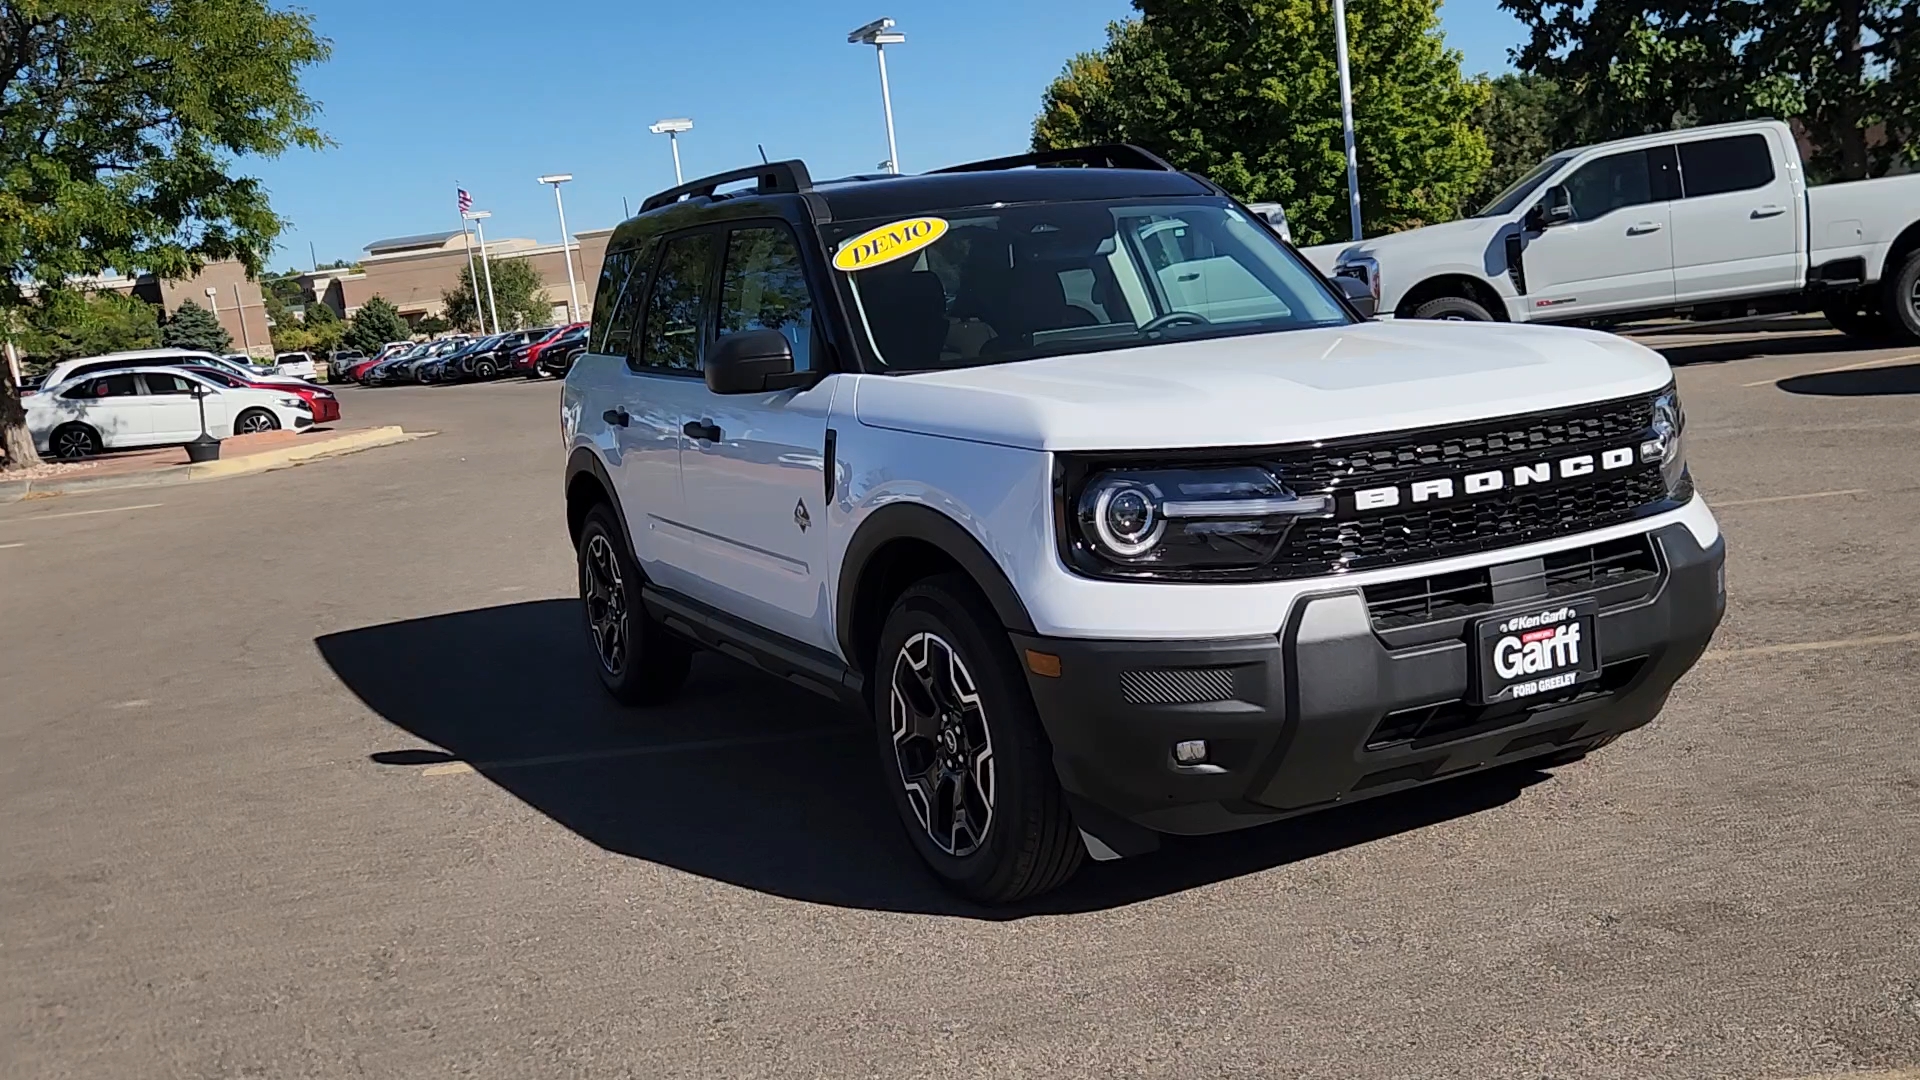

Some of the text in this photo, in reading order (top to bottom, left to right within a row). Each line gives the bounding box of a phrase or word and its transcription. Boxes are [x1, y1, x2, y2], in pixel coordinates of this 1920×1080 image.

[853, 220, 931, 265] DEMO
[1354, 447, 1634, 511] BRONCO
[1518, 607, 1569, 630] Ken Garff
[1493, 622, 1581, 679] Garff
[1512, 672, 1577, 699] FORD GREELEY
